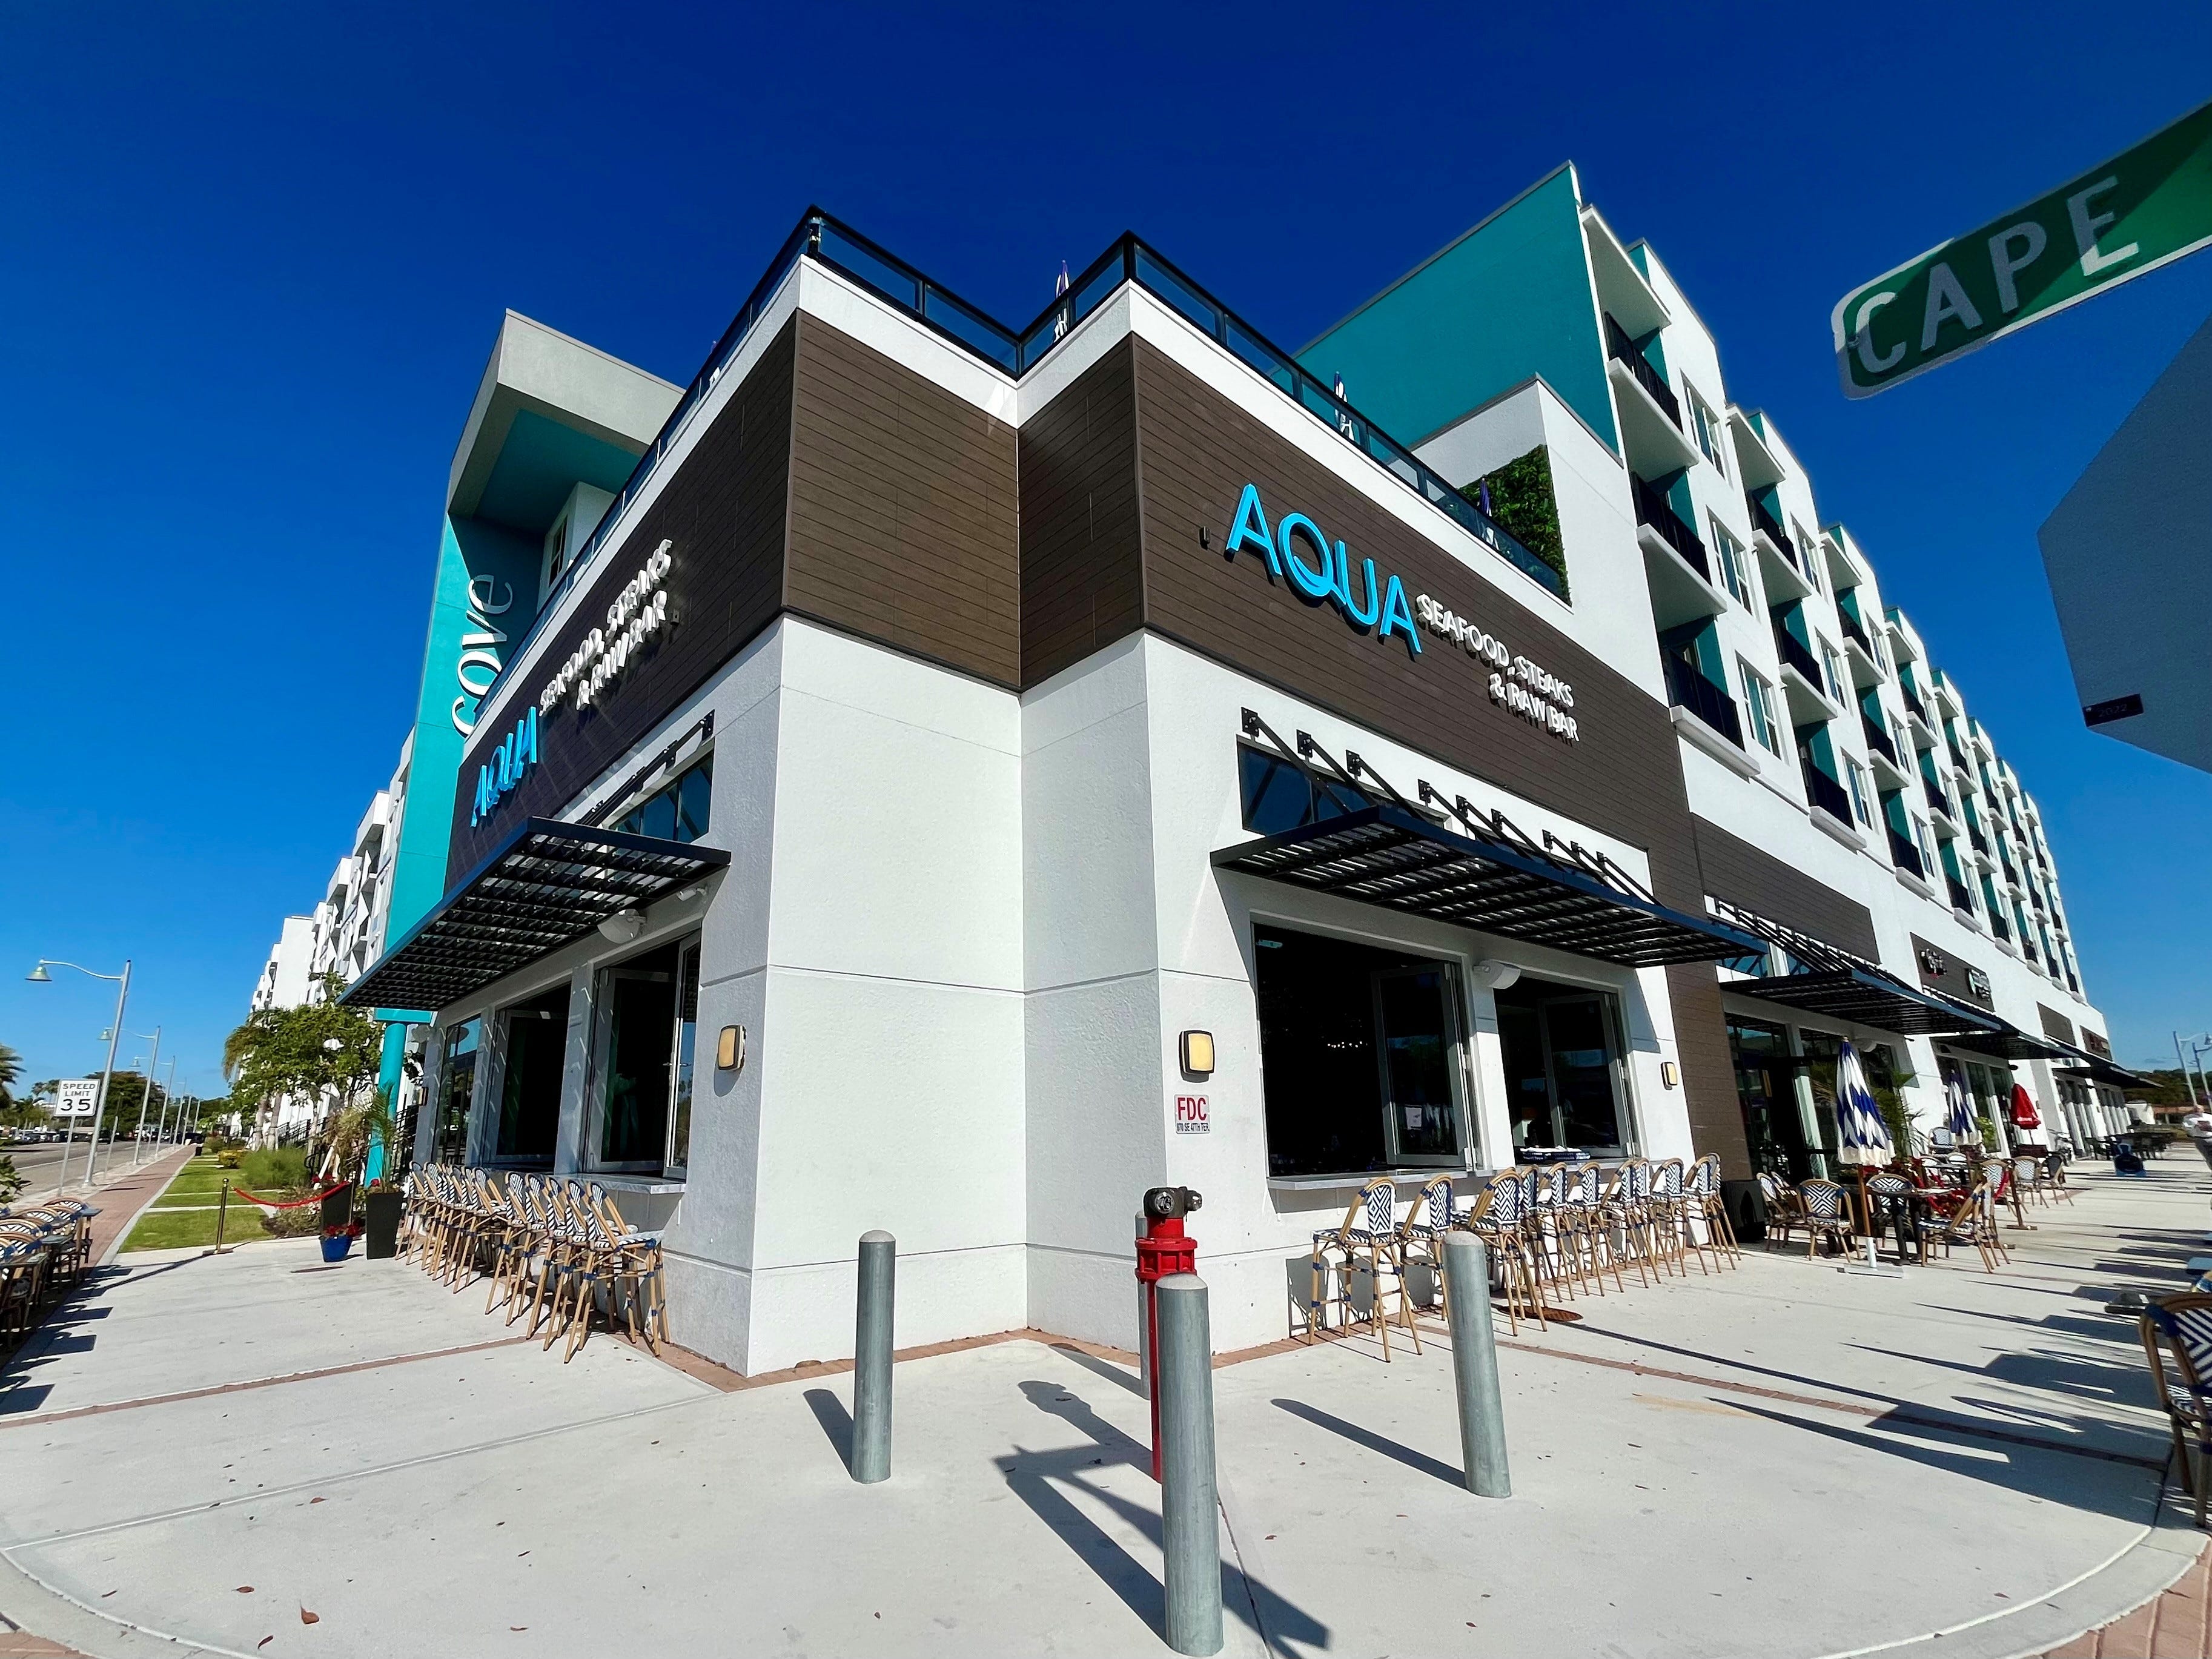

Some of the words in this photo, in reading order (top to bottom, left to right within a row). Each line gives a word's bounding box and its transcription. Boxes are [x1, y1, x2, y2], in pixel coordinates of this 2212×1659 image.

[1856, 175, 2139, 373] CAPE
[1225, 483, 1422, 654] AQUA
[1489, 672, 1507, 701] &
[1505, 682, 1546, 722] RAW
[1545, 705, 1580, 742] BAR
[1514, 655, 1574, 707] STEAKS
[471, 706, 537, 827] AQUA
[60, 1098, 91, 1111] 35
[1177, 1097, 1207, 1121] FDC
[1184, 1122, 1190, 1131] SE
